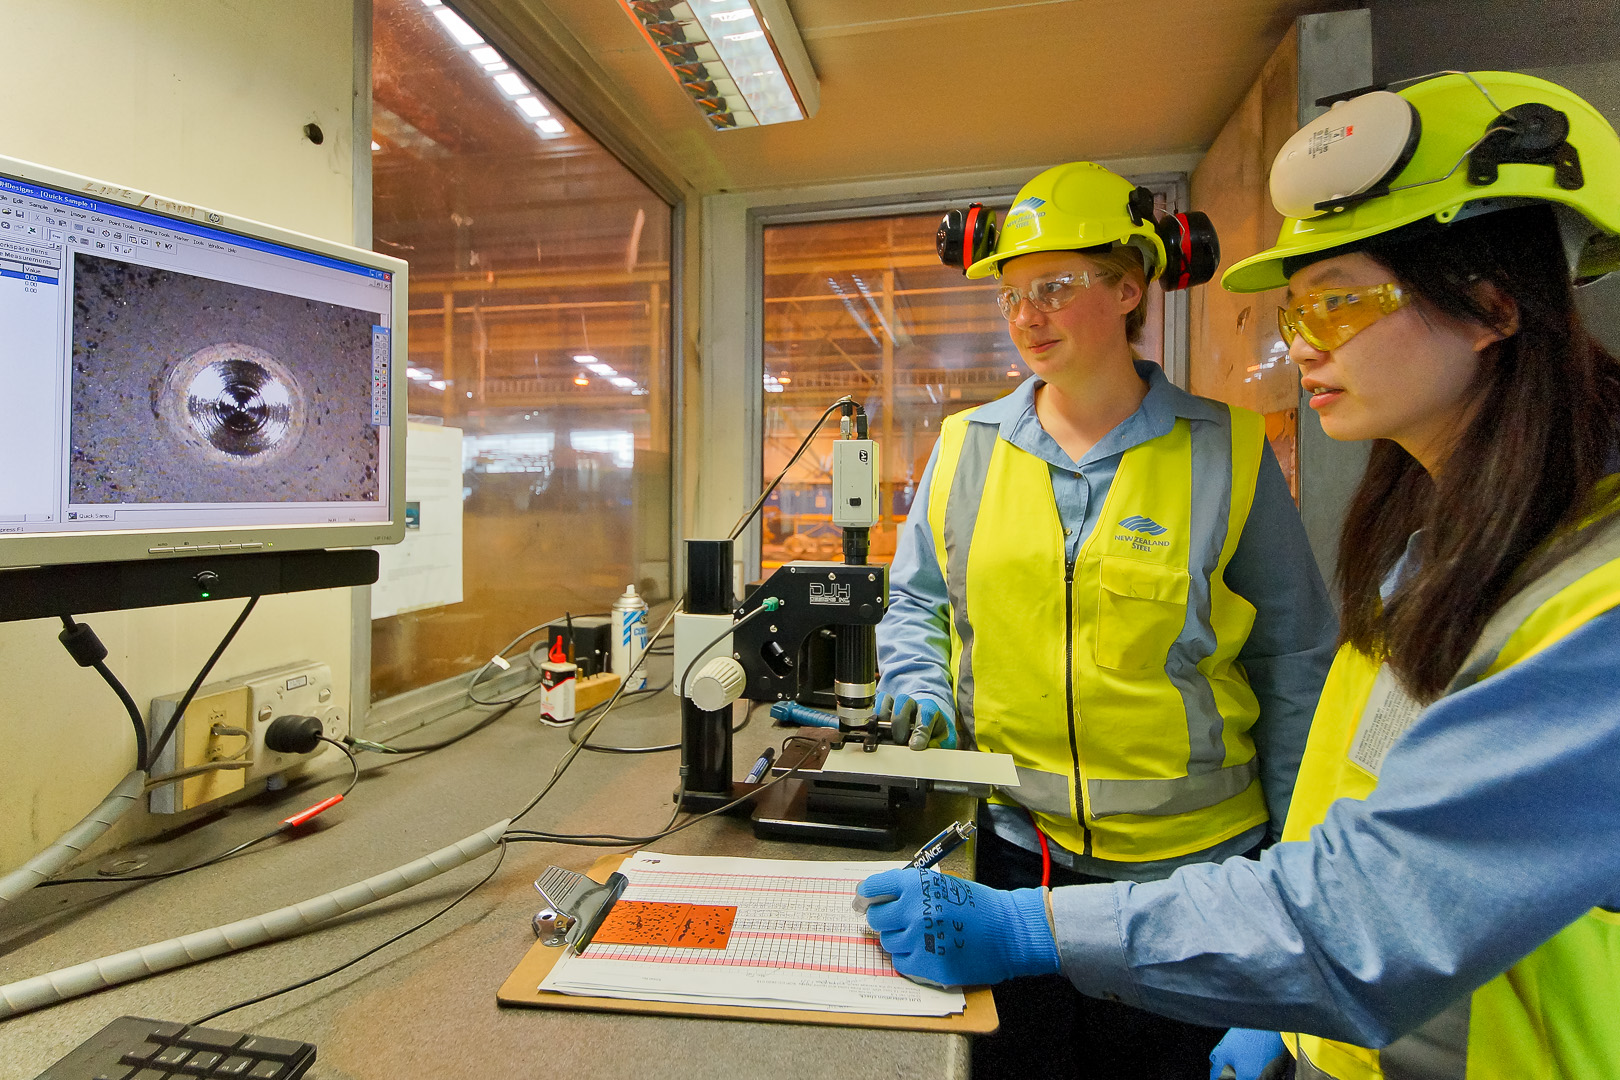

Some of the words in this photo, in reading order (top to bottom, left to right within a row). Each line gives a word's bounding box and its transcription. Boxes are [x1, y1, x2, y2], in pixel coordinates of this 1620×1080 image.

[40, 190, 63, 202] [Quick
[64, 196, 89, 208] Sample
[29, 202, 48, 210] Sample
[70, 211, 86, 219] Image
[91, 215, 104, 223] Color
[31, 247, 49, 255] Items
[5, 252, 52, 265] Measurements
[25, 266, 41, 274] Value
[1131, 542, 1152, 553] STEEL
[1134, 536, 1170, 547] ZEALAND
[810, 582, 850, 598] DJH
[914, 843, 943, 869] BOUNCE
[952, 920, 965, 949] CE
